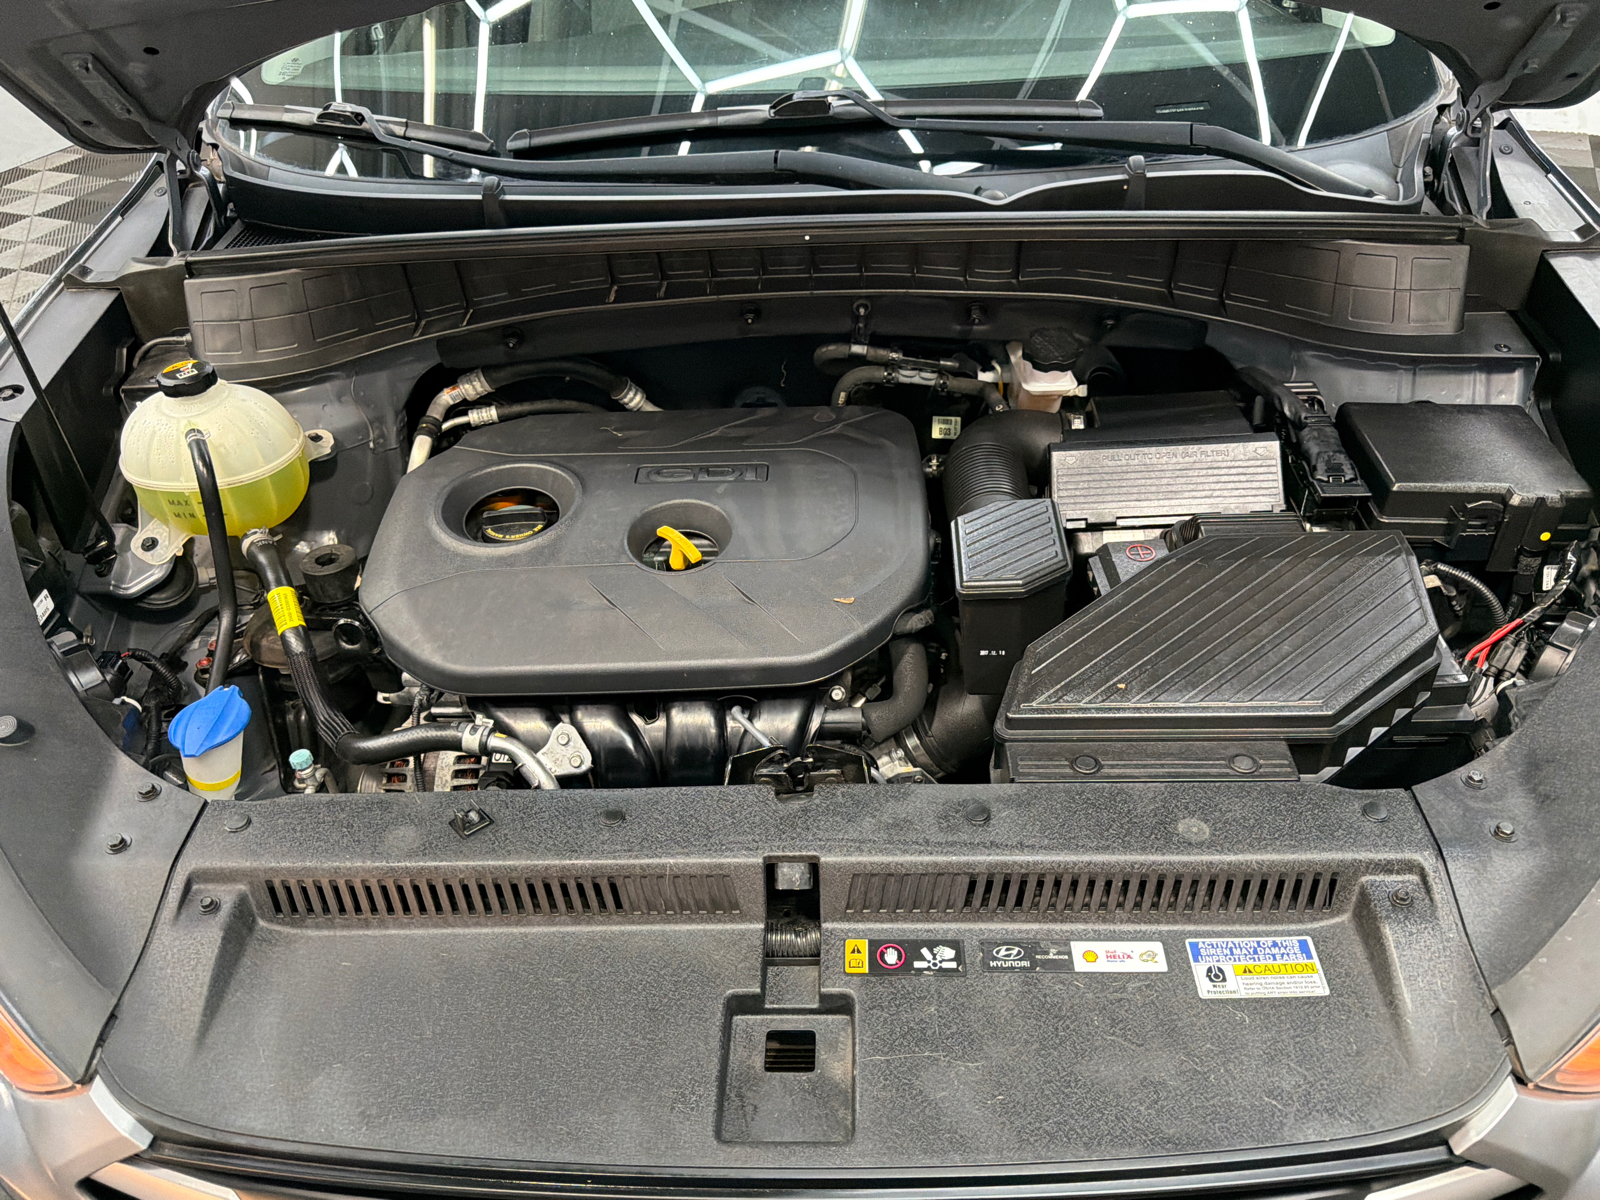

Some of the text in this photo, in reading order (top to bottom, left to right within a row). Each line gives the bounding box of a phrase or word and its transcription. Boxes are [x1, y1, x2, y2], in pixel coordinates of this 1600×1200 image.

[1102, 454, 1122, 462] PULL
[1124, 453, 1140, 461] OUT
[1155, 452, 1178, 460] OPEN
[647, 466, 760, 481] GDI
[167, 499, 190, 507] MAX
[1198, 939, 1299, 949] ACTIVATION OF THIS
[1200, 946, 1301, 956] SIREN MAY DAMAGE
[1198, 953, 1307, 963] UNPROTECTED EARS!
[989, 960, 1030, 968] HYUNDAI
[1252, 963, 1316, 974] CAUTION
